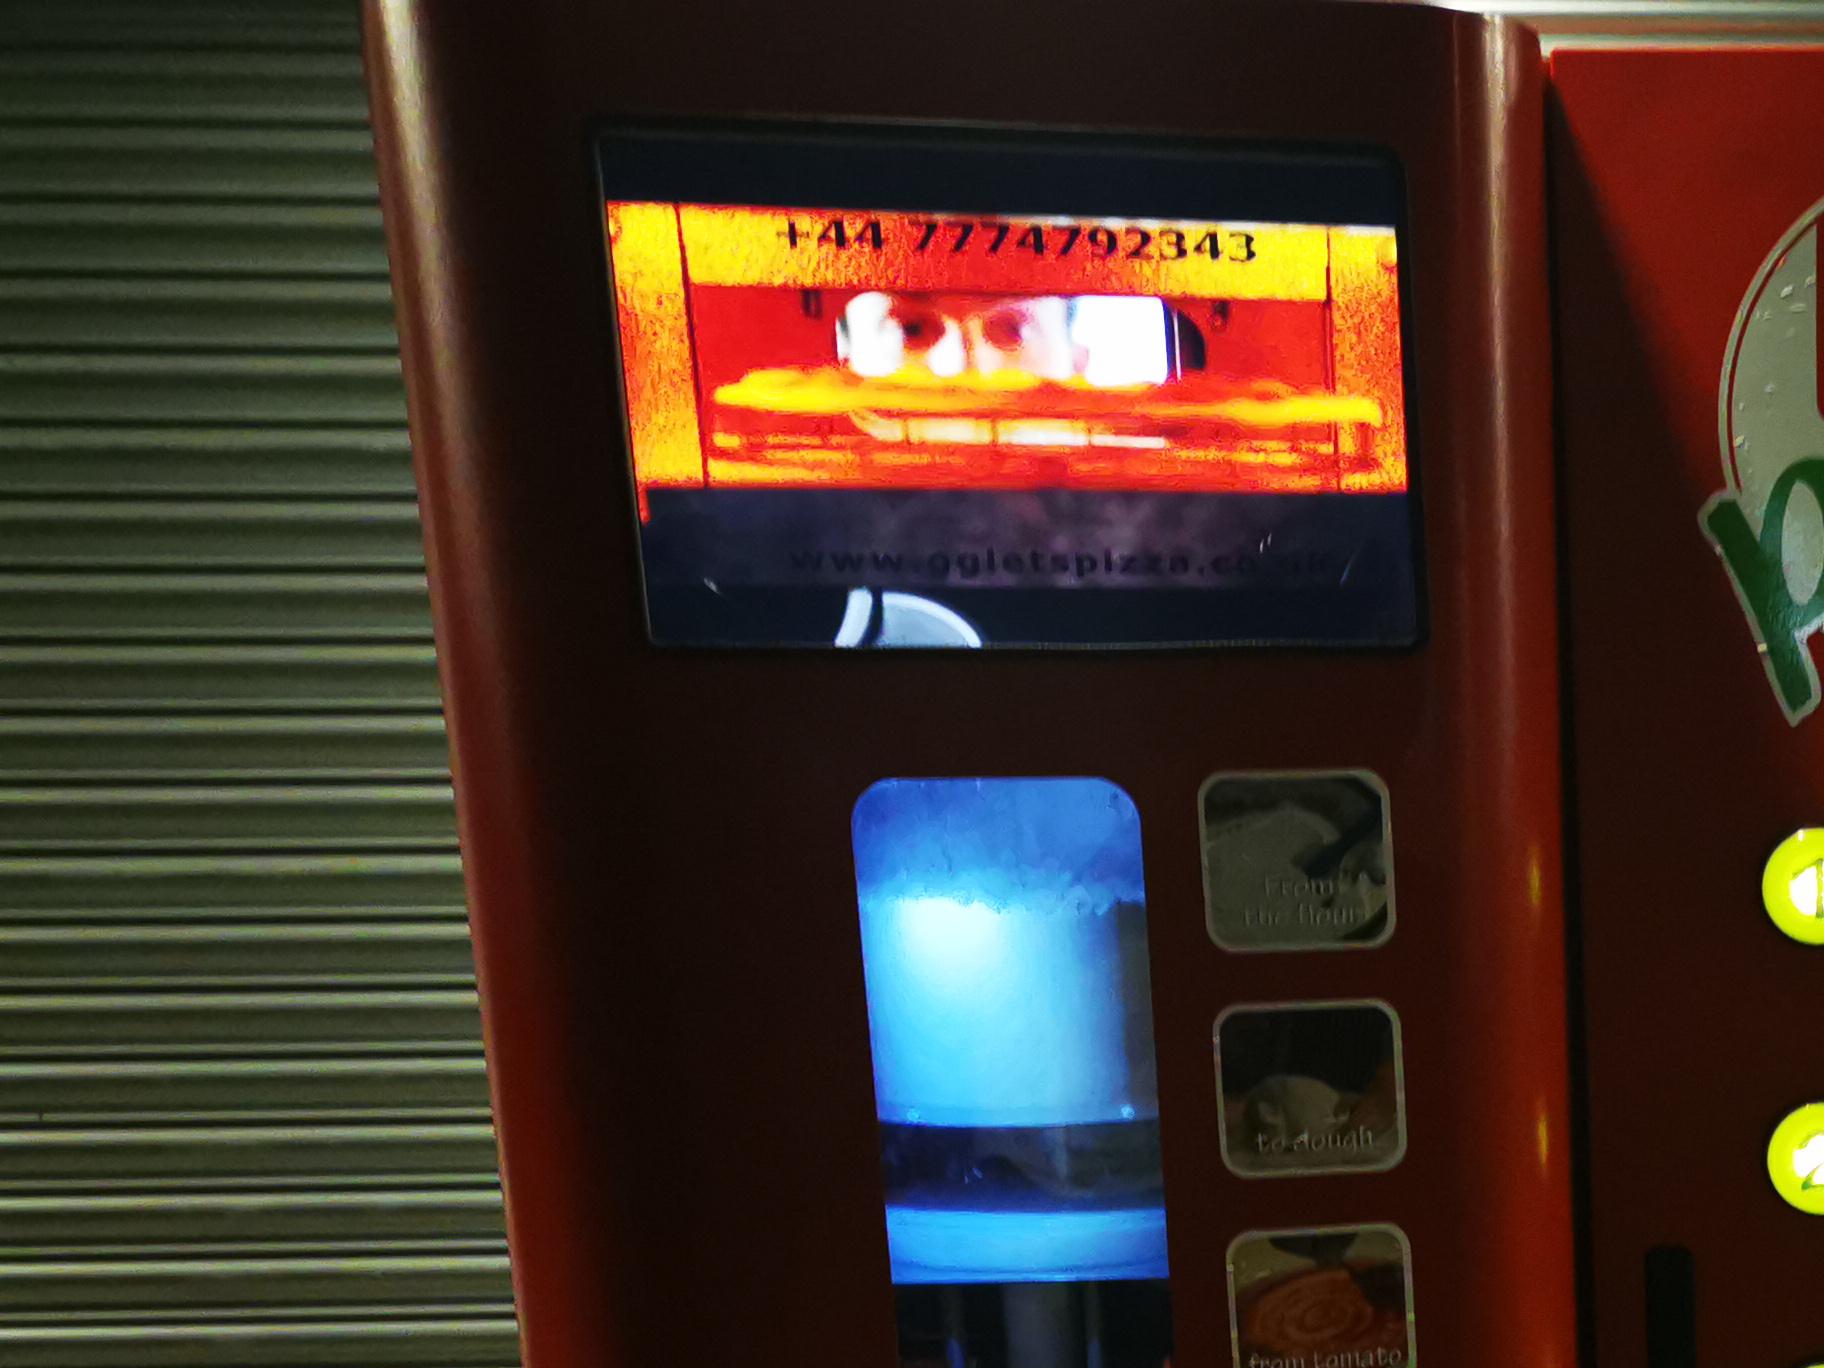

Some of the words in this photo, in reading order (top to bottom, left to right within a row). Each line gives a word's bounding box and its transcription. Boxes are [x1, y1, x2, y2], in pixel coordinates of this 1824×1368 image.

[776, 218, 884, 251] +44
[913, 220, 1257, 262] 7774792343
[1792, 857, 1824, 920] 1
